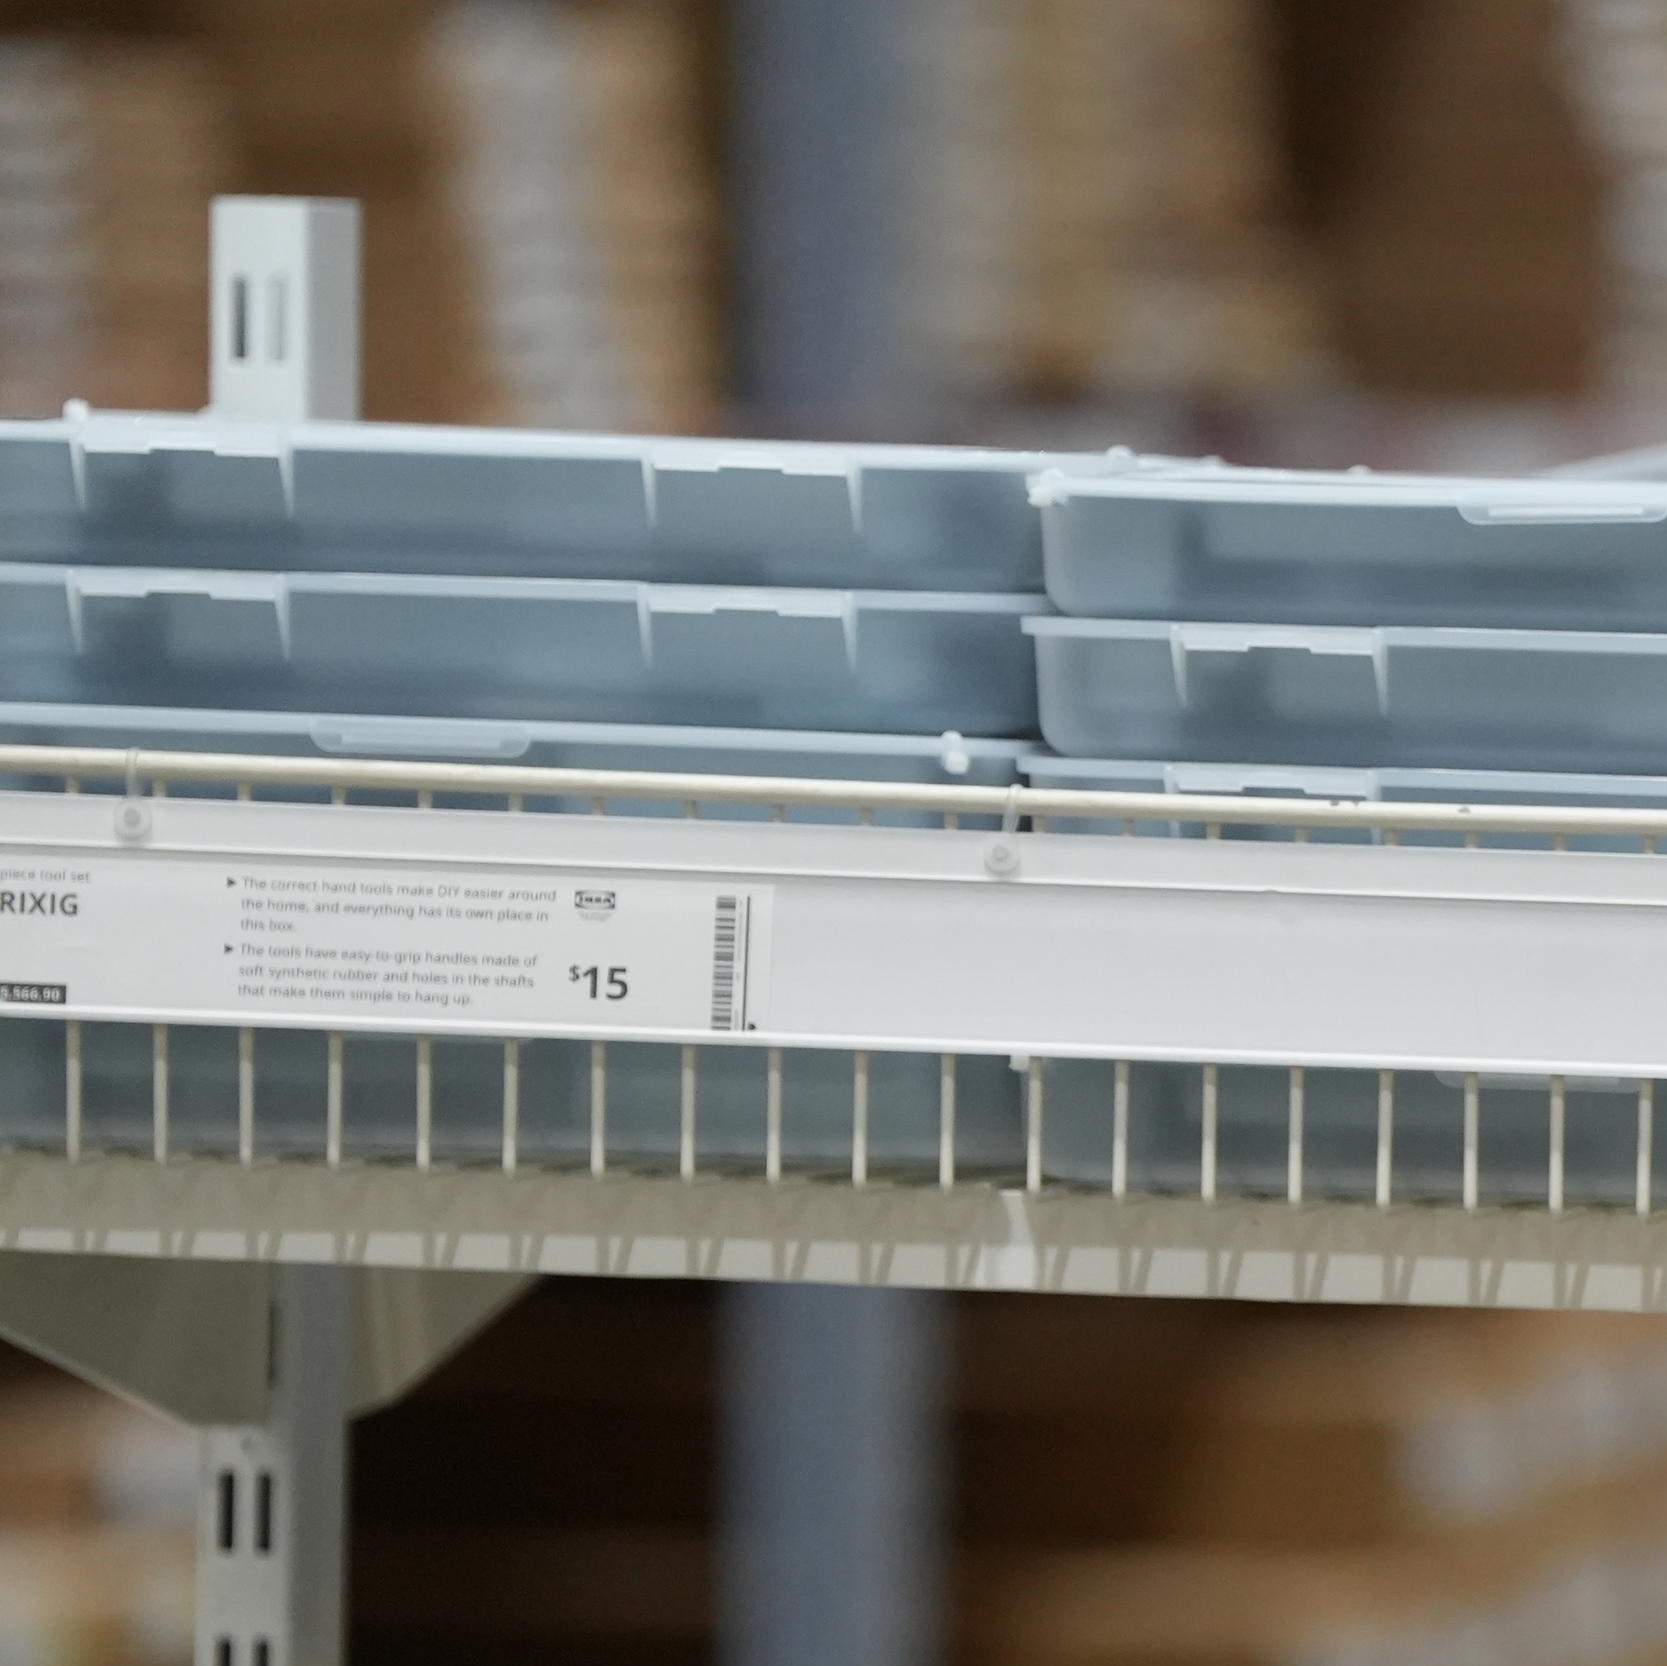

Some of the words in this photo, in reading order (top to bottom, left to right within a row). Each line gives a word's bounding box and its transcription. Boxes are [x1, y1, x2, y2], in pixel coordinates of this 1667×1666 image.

[242, 877, 266, 889] The
[271, 879, 317, 892] correct
[322, 879, 356, 893] hand
[360, 882, 392, 895] tools
[397, 882, 433, 896] make
[437, 884, 460, 897] DIY
[464, 887, 503, 900] easier
[507, 889, 557, 902] around
[0, 890, 78, 916] RIXIG
[241, 899, 263, 911] the
[267, 899, 309, 914] home,
[313, 901, 340, 913] and
[343, 902, 415, 920] everything
[418, 905, 442, 918] has
[445, 906, 462, 919] its
[465, 908, 493, 920] own
[497, 908, 533, 924] place
[536, 910, 549, 922] in
[240, 918, 265, 931] this
[268, 918, 296, 932] box.
[241, 942, 264, 956] The
[268, 945, 302, 958] tools
[305, 945, 337, 959] have
[425, 951, 478, 966] handles
[481, 954, 520, 967] made
[523, 953, 539, 967] of
[238, 965, 263, 977] soft
[268, 966, 329, 981] synthetic
[332, 968, 379, 980] rubber
[382, 971, 409, 983] and
[412, 971, 449, 985] holes
[451, 974, 464, 985] in
[468, 973, 490, 986] the
[494, 974, 535, 988] shafts
[568, 964, 629, 1001] $15
[238, 984, 265, 996] that
[268, 985, 306, 998] make
[309, 986, 345, 999] them
[350, 989, 393, 1004] simple
[397, 991, 411, 1002] to
[414, 990, 449, 1007] hang
[452, 994, 473, 1007] up.
